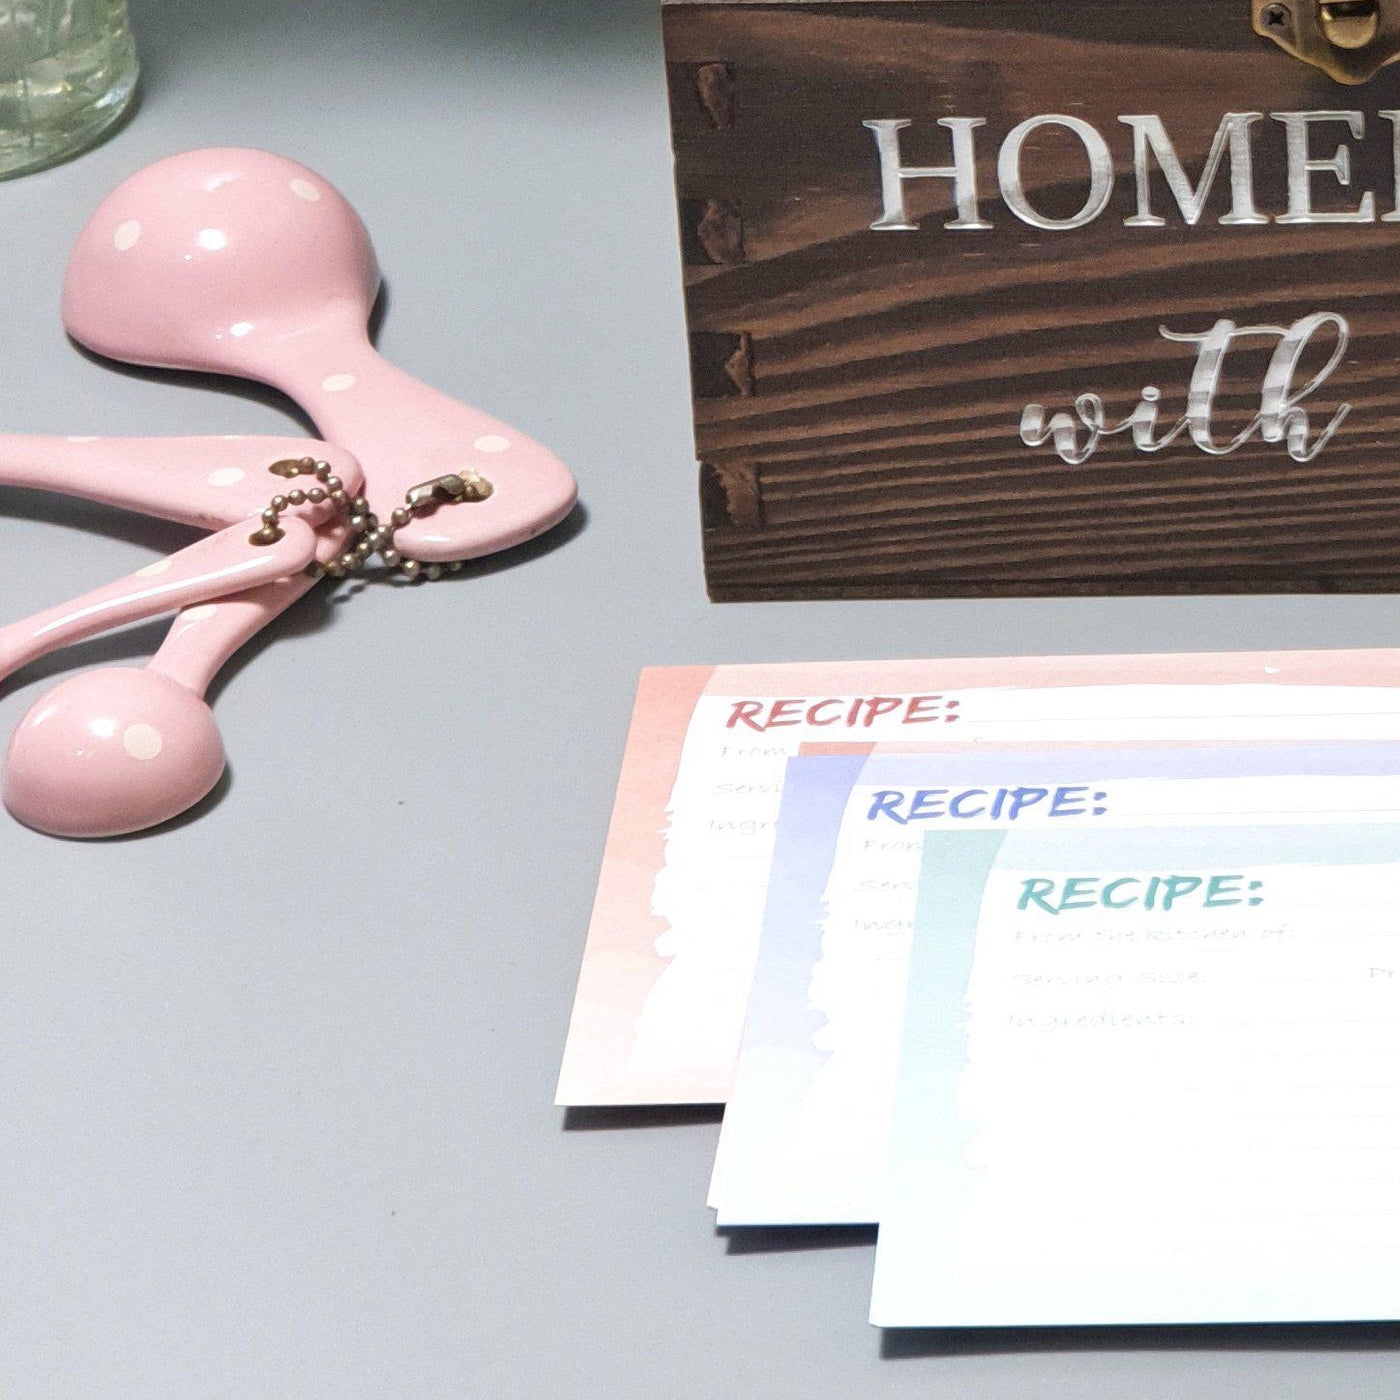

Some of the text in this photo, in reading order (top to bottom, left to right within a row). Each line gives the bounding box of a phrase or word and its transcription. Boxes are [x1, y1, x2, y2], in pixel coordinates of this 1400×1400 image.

[1018, 311, 1352, 466] with
[725, 695, 960, 731] RECIPE:
[866, 786, 1108, 825] RECIPE:
[1016, 874, 1265, 915] RECIPE:
